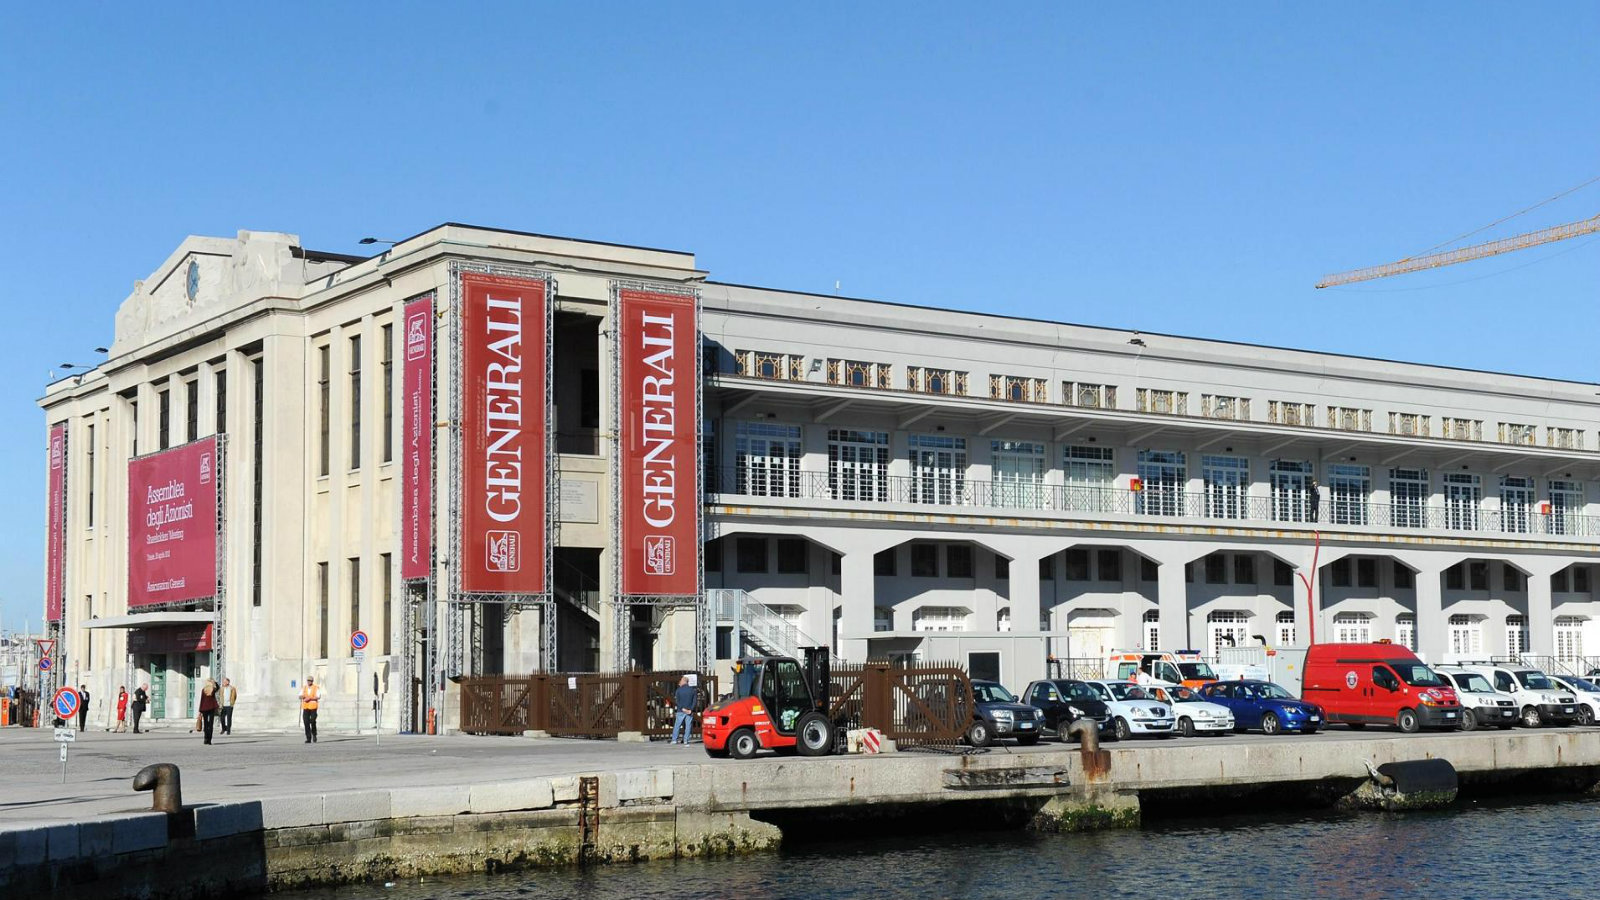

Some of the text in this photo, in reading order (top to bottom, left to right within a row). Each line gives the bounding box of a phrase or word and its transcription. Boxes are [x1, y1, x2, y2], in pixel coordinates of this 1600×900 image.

[486, 294, 522, 522] GENERALI
[642, 310, 675, 528] GENERALI
[412, 451, 420, 485] degli
[146, 480, 184, 504] Assemblea
[146, 498, 193, 530] degli Azionisti
